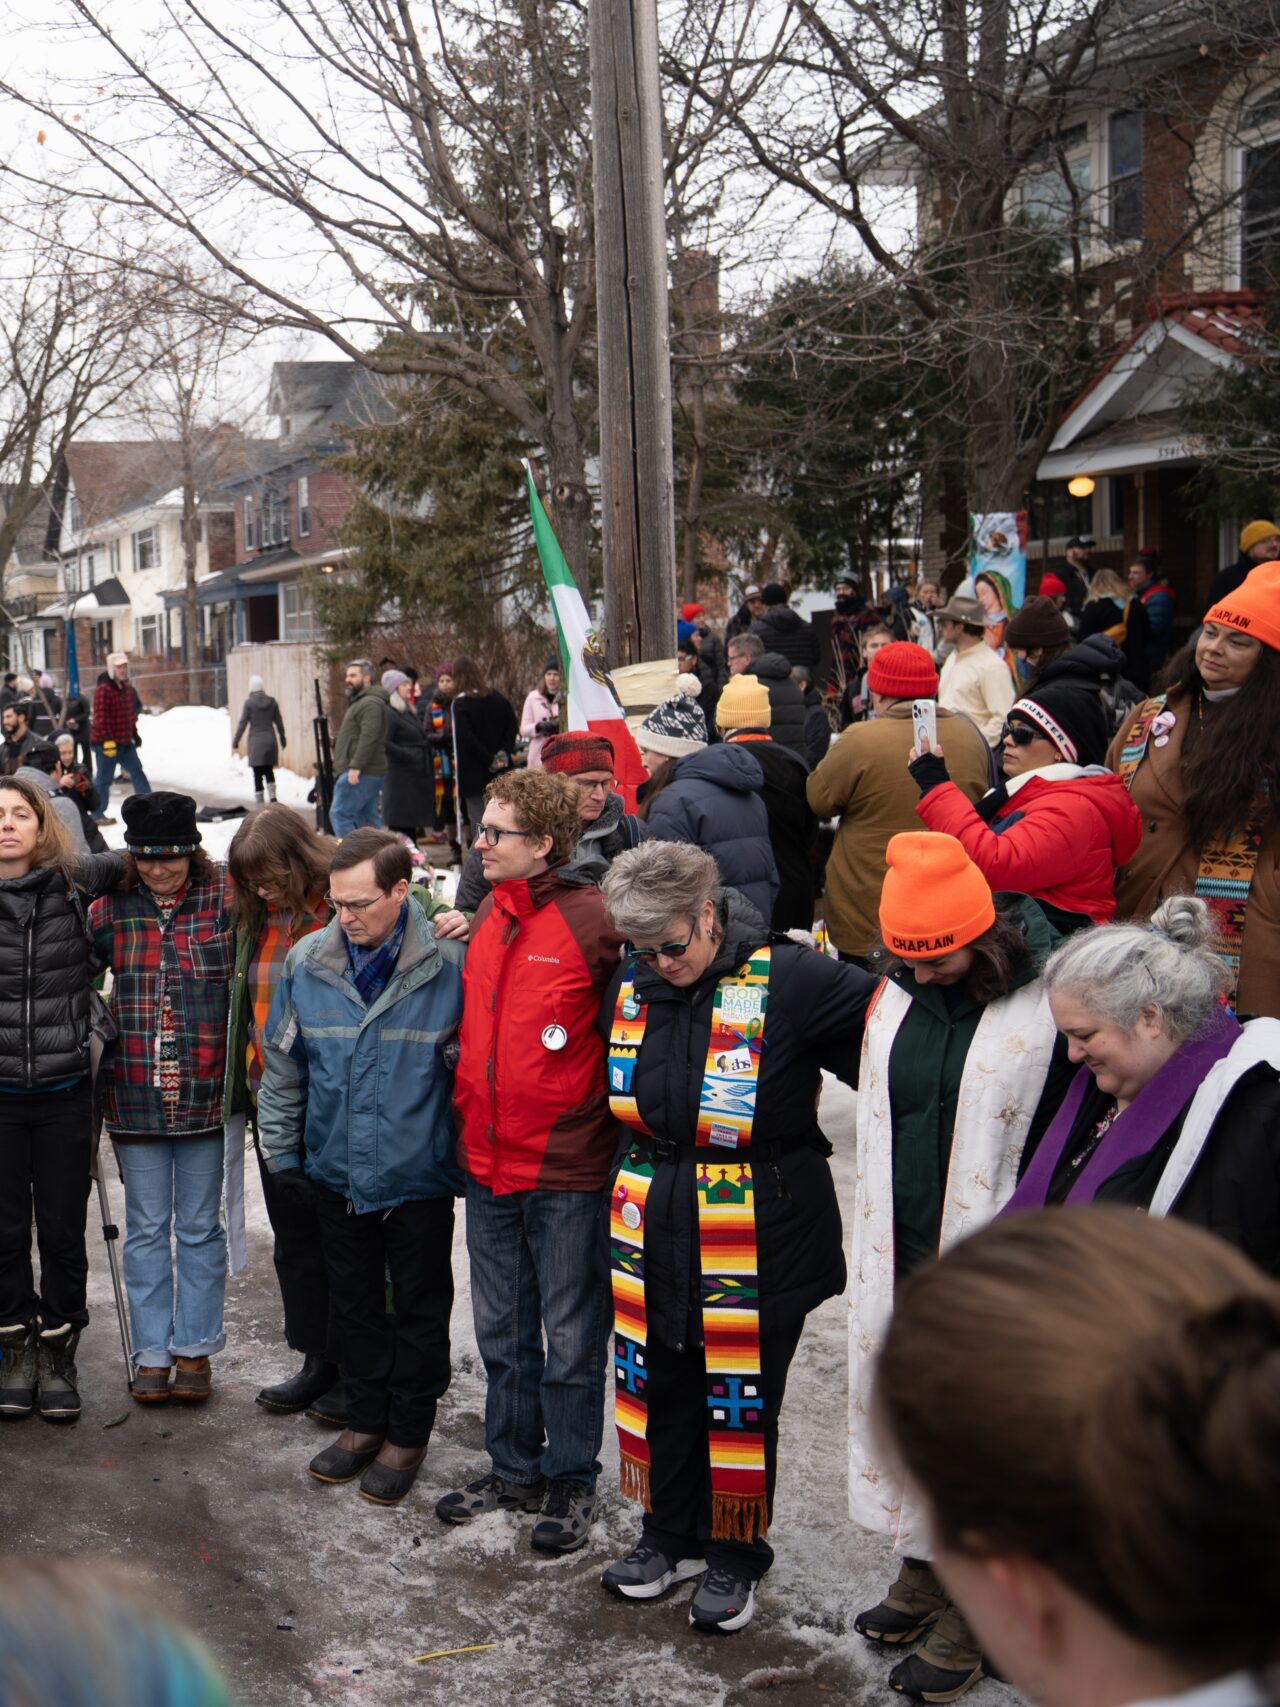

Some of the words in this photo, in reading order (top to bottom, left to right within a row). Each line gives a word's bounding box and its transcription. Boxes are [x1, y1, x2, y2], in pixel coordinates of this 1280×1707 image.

[1211, 609, 1251, 629] APLAIN
[1022, 702, 1065, 743] HUNTER
[892, 934, 954, 952] CHAPLAIN
[724, 987, 761, 1000] GOD
[723, 998, 760, 1010] MADE
[731, 1057, 752, 1071] abs
